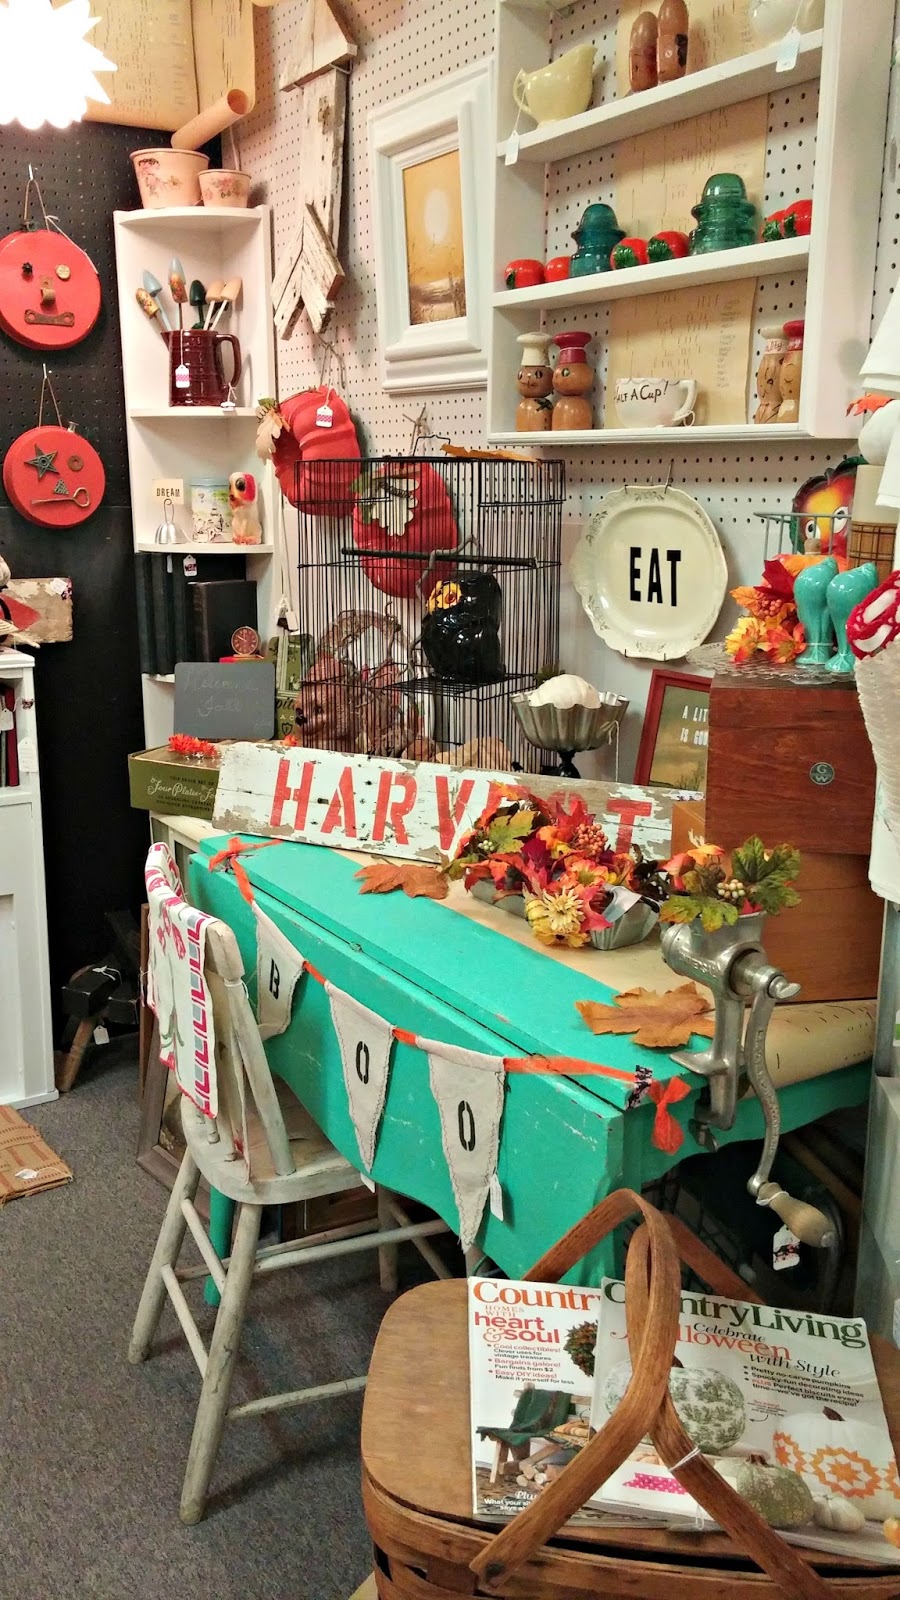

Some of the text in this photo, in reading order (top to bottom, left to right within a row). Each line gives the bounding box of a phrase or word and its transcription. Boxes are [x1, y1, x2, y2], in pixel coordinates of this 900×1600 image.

[631, 388, 639, 401] A
[640, 380, 669, 403] Cup!
[156, 488, 181, 497] DREAM
[629, 547, 682, 607] EAT
[682, 705, 689, 719] A
[680, 728, 689, 742] IS
[270, 759, 653, 853] HARVT
[473, 1281, 601, 1311] Countr
[485, 1304, 524, 1313] HOMES
[474, 1311, 545, 1331] heart
[503, 1329, 560, 1344] soul
[693, 1322, 766, 1342] Celebrate
[494, 1358, 531, 1366] Bargains
[750, 1354, 840, 1379] with Style
[495, 1369, 515, 1377] Easy
[751, 1366, 774, 1376] Pretty
[842, 1390, 865, 1398] ideas
